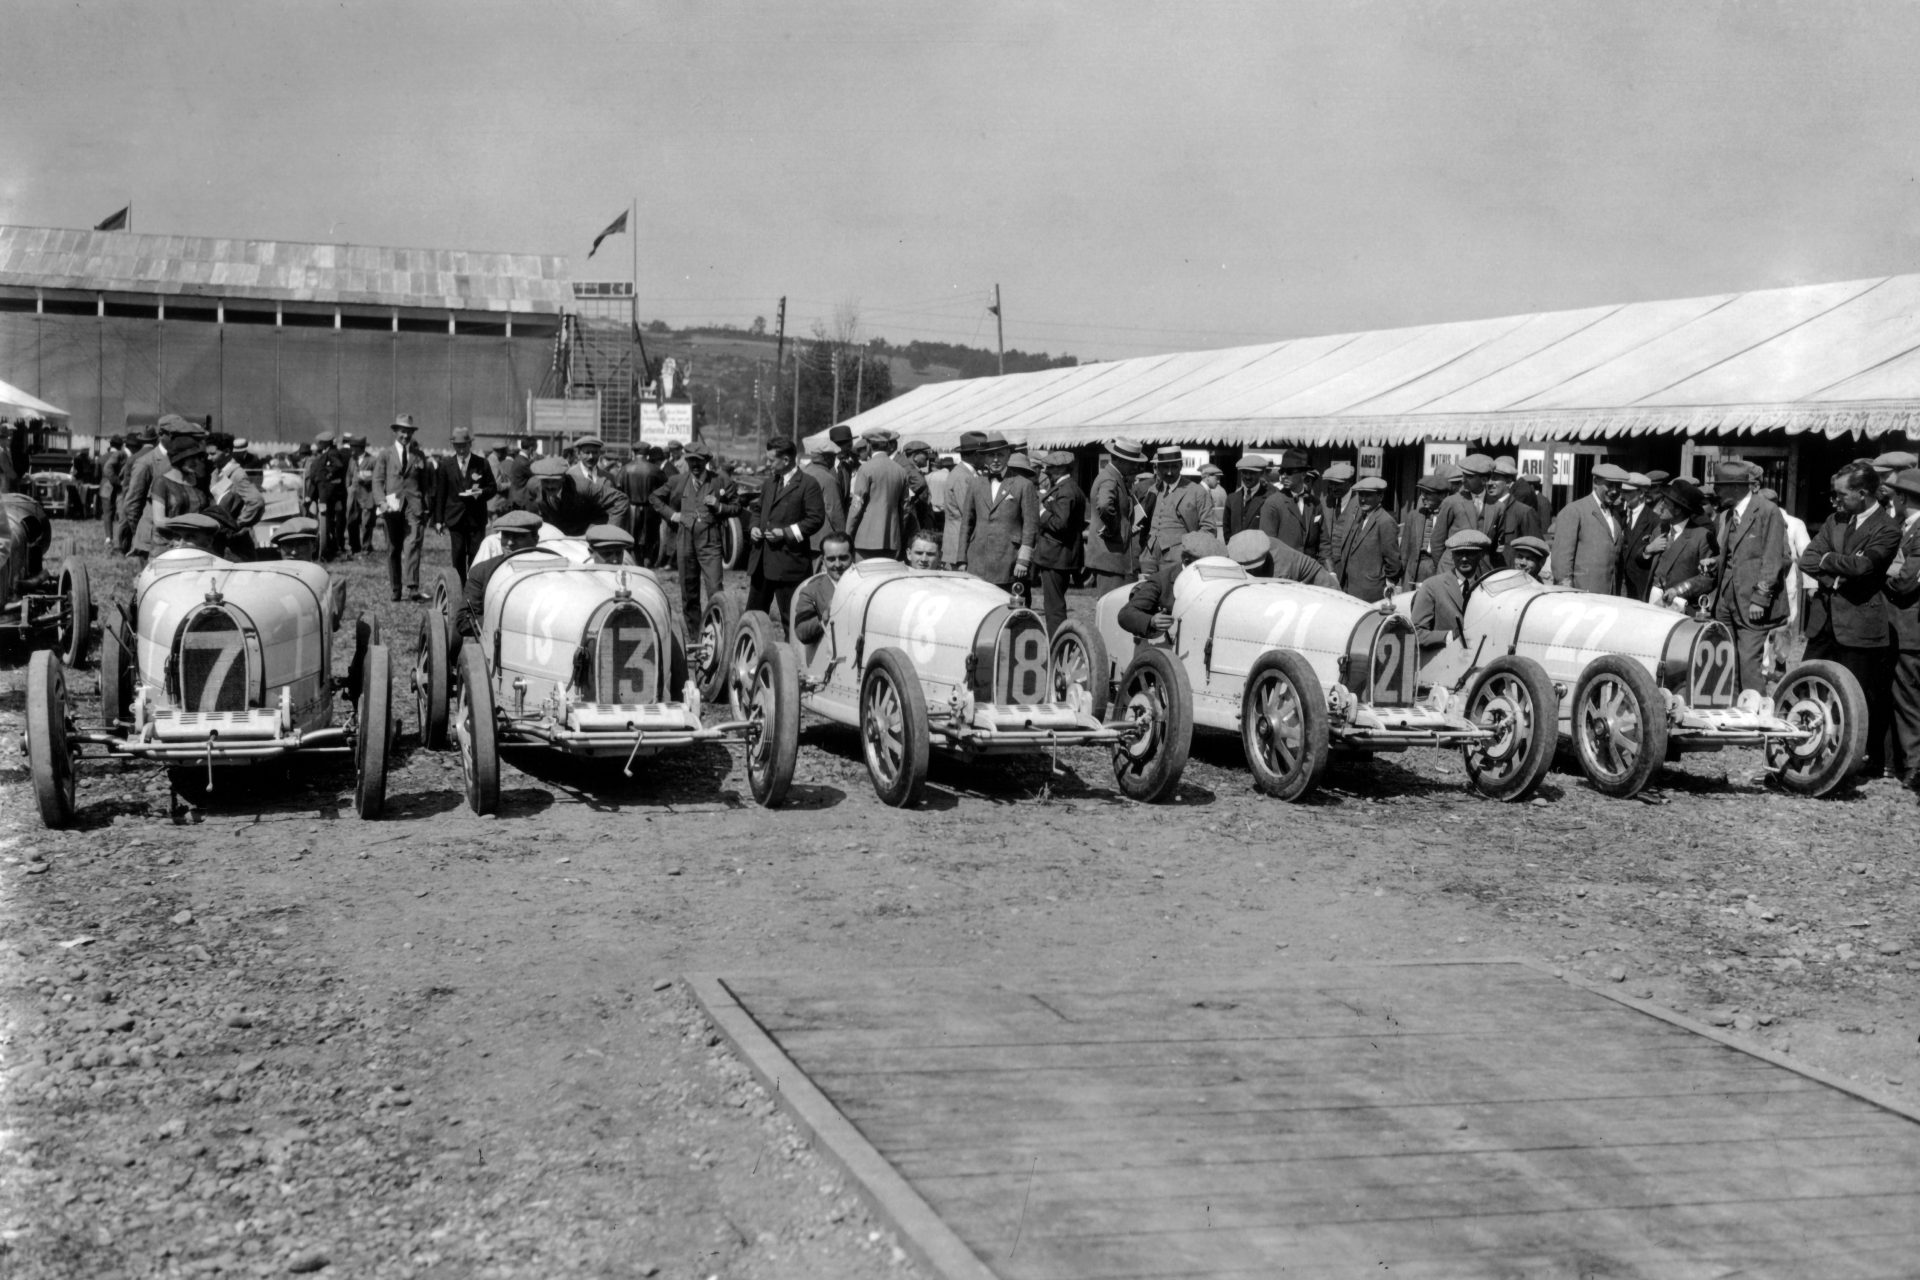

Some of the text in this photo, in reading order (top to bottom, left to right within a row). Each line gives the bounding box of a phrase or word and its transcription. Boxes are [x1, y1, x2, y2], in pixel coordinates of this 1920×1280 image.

[667, 424, 690, 435] ZENITH
[1361, 454, 1376, 468] ARIES
[1522, 459, 1558, 475] ARIS
[900, 590, 950, 664] 18
[1259, 601, 1322, 654] 21
[184, 630, 245, 713] 7
[599, 627, 659, 705] 13
[997, 628, 1048, 705] 18
[1374, 633, 1416, 704] 21
[1693, 640, 1735, 705] 22
